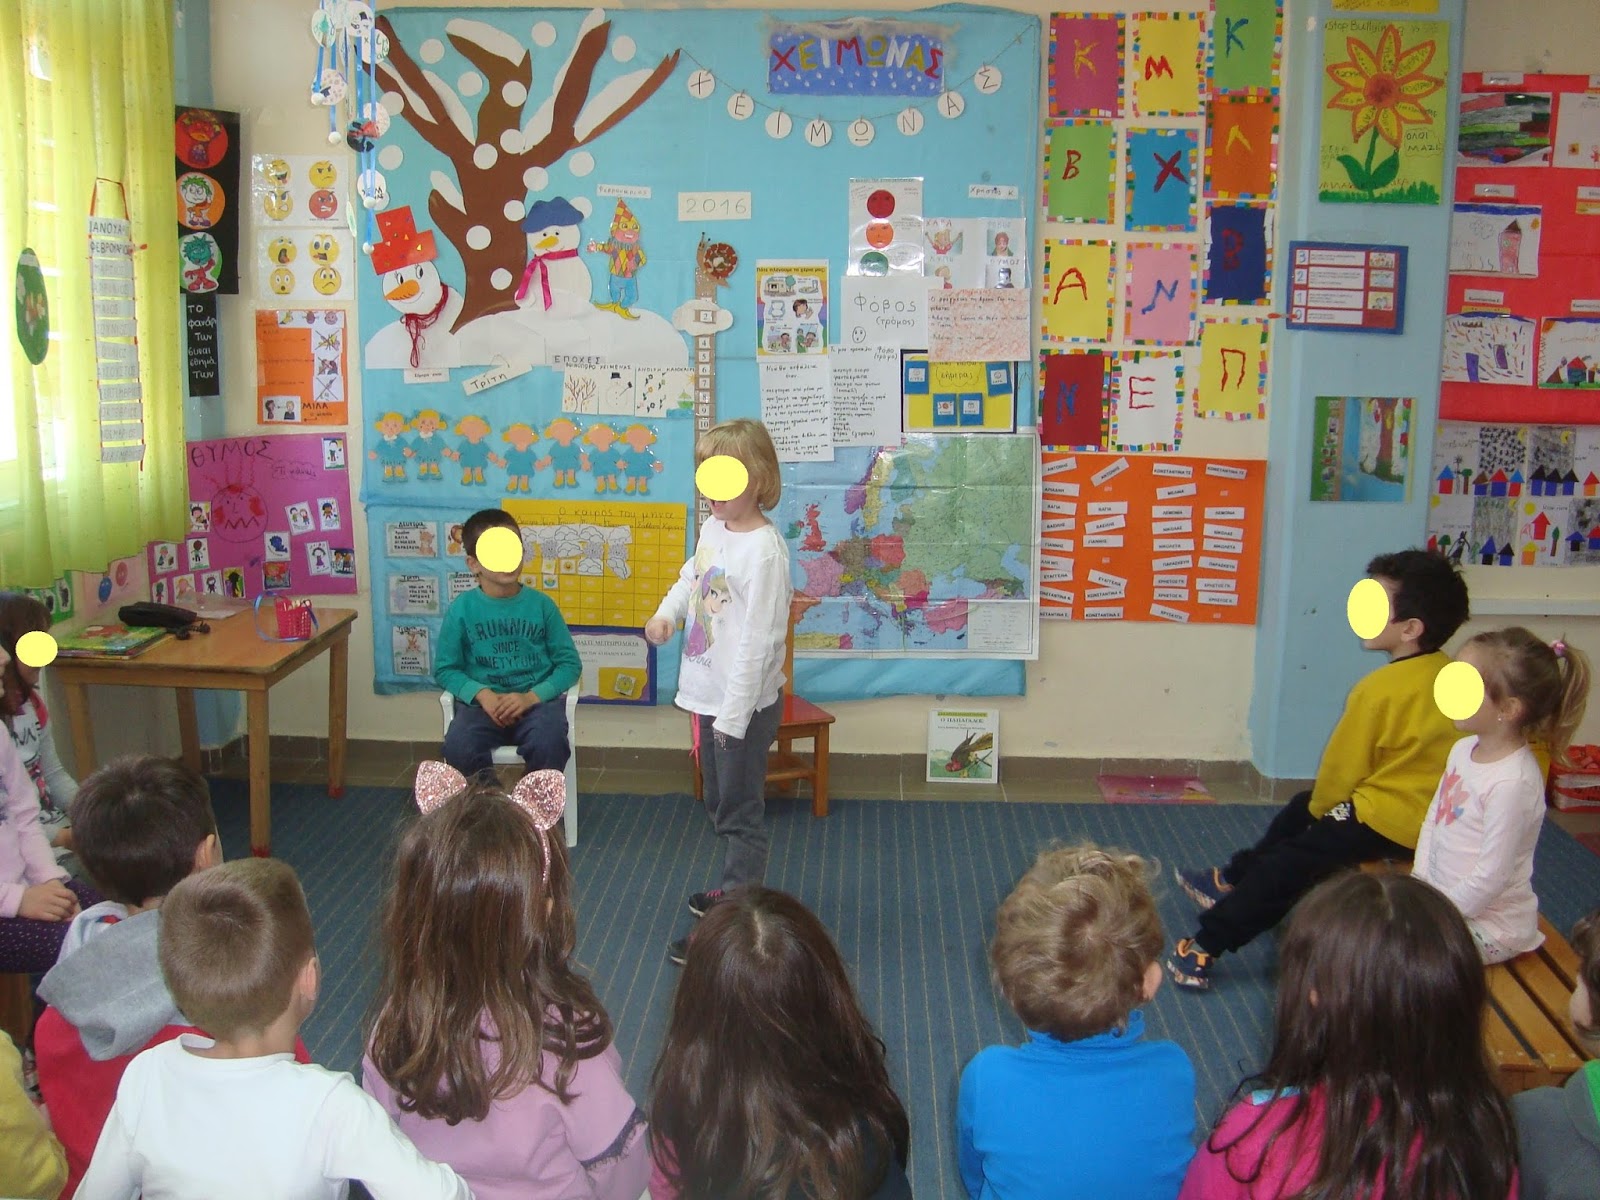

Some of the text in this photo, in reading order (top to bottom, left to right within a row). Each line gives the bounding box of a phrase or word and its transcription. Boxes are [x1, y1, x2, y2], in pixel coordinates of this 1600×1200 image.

[686, 198, 747, 215] 2016
[1299, 251, 1306, 263] 3
[700, 420, 708, 428] 10
[492, 641, 520, 654] SINCE
